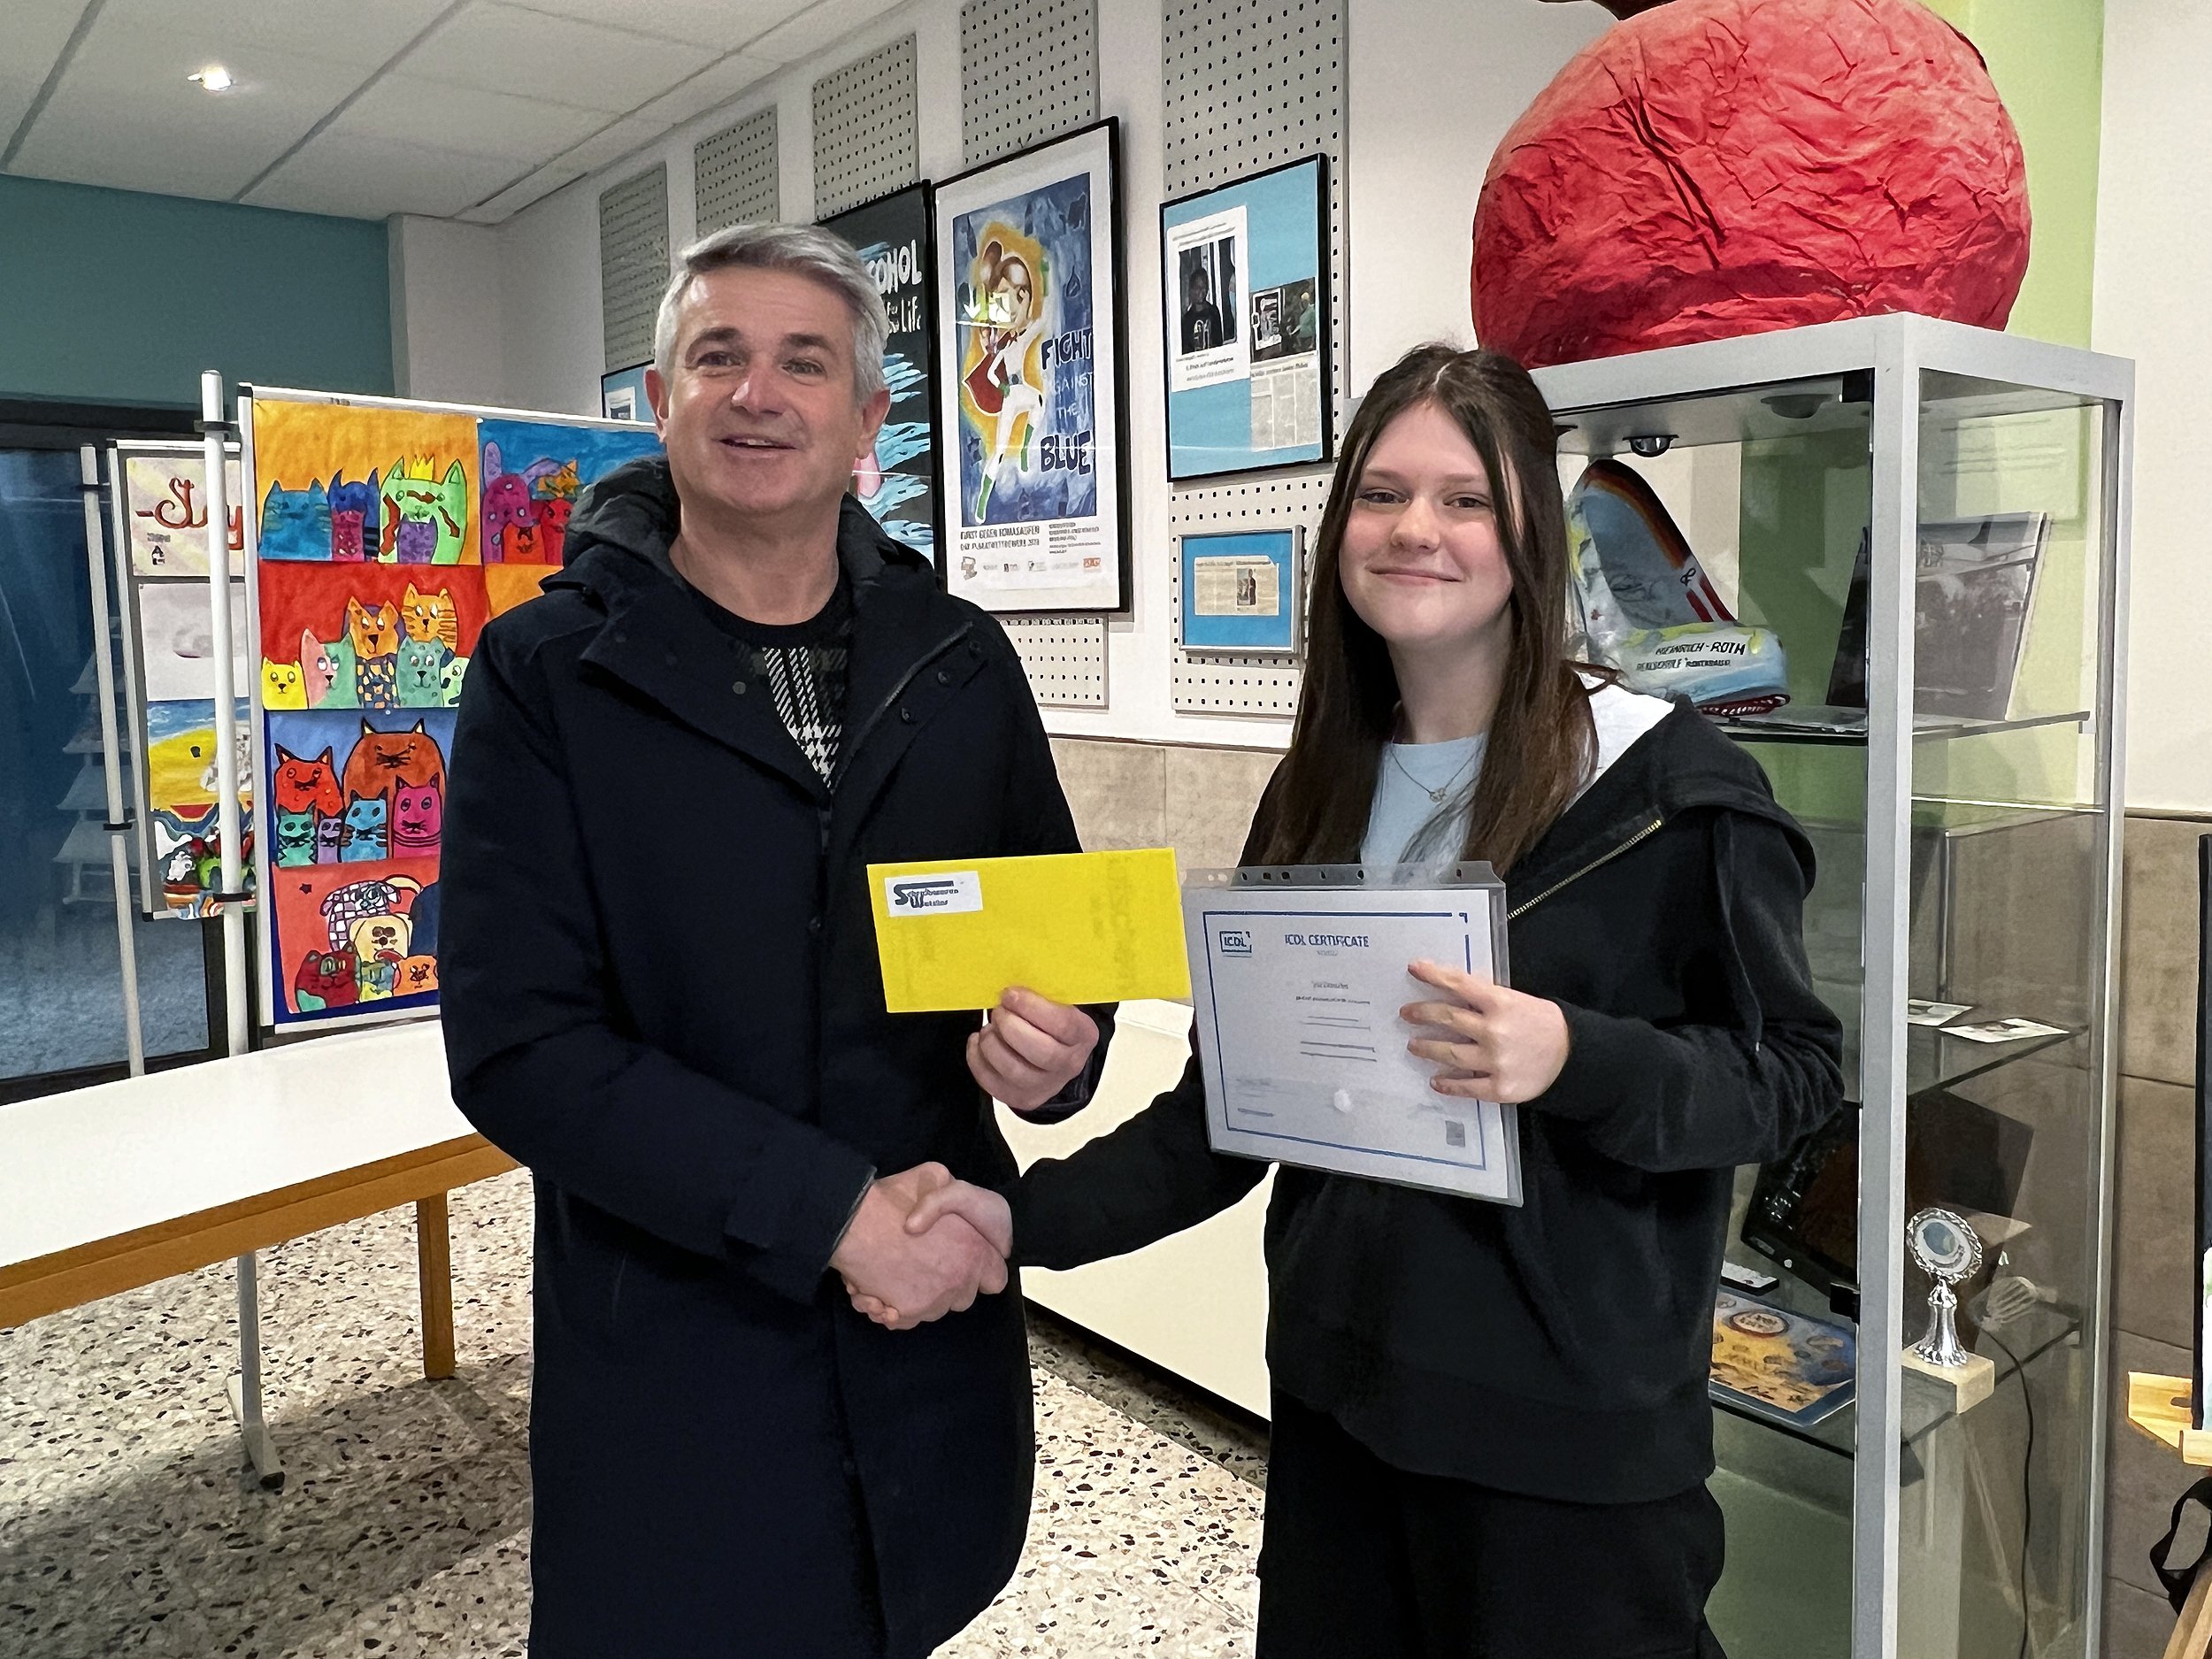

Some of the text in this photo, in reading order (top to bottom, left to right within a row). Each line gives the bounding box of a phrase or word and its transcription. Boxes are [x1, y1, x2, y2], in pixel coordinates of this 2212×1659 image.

[1041, 326, 1093, 370] FIGHT
[1041, 430, 1092, 475] BLUE
[1309, 934, 1370, 948] CERTIFICATE
